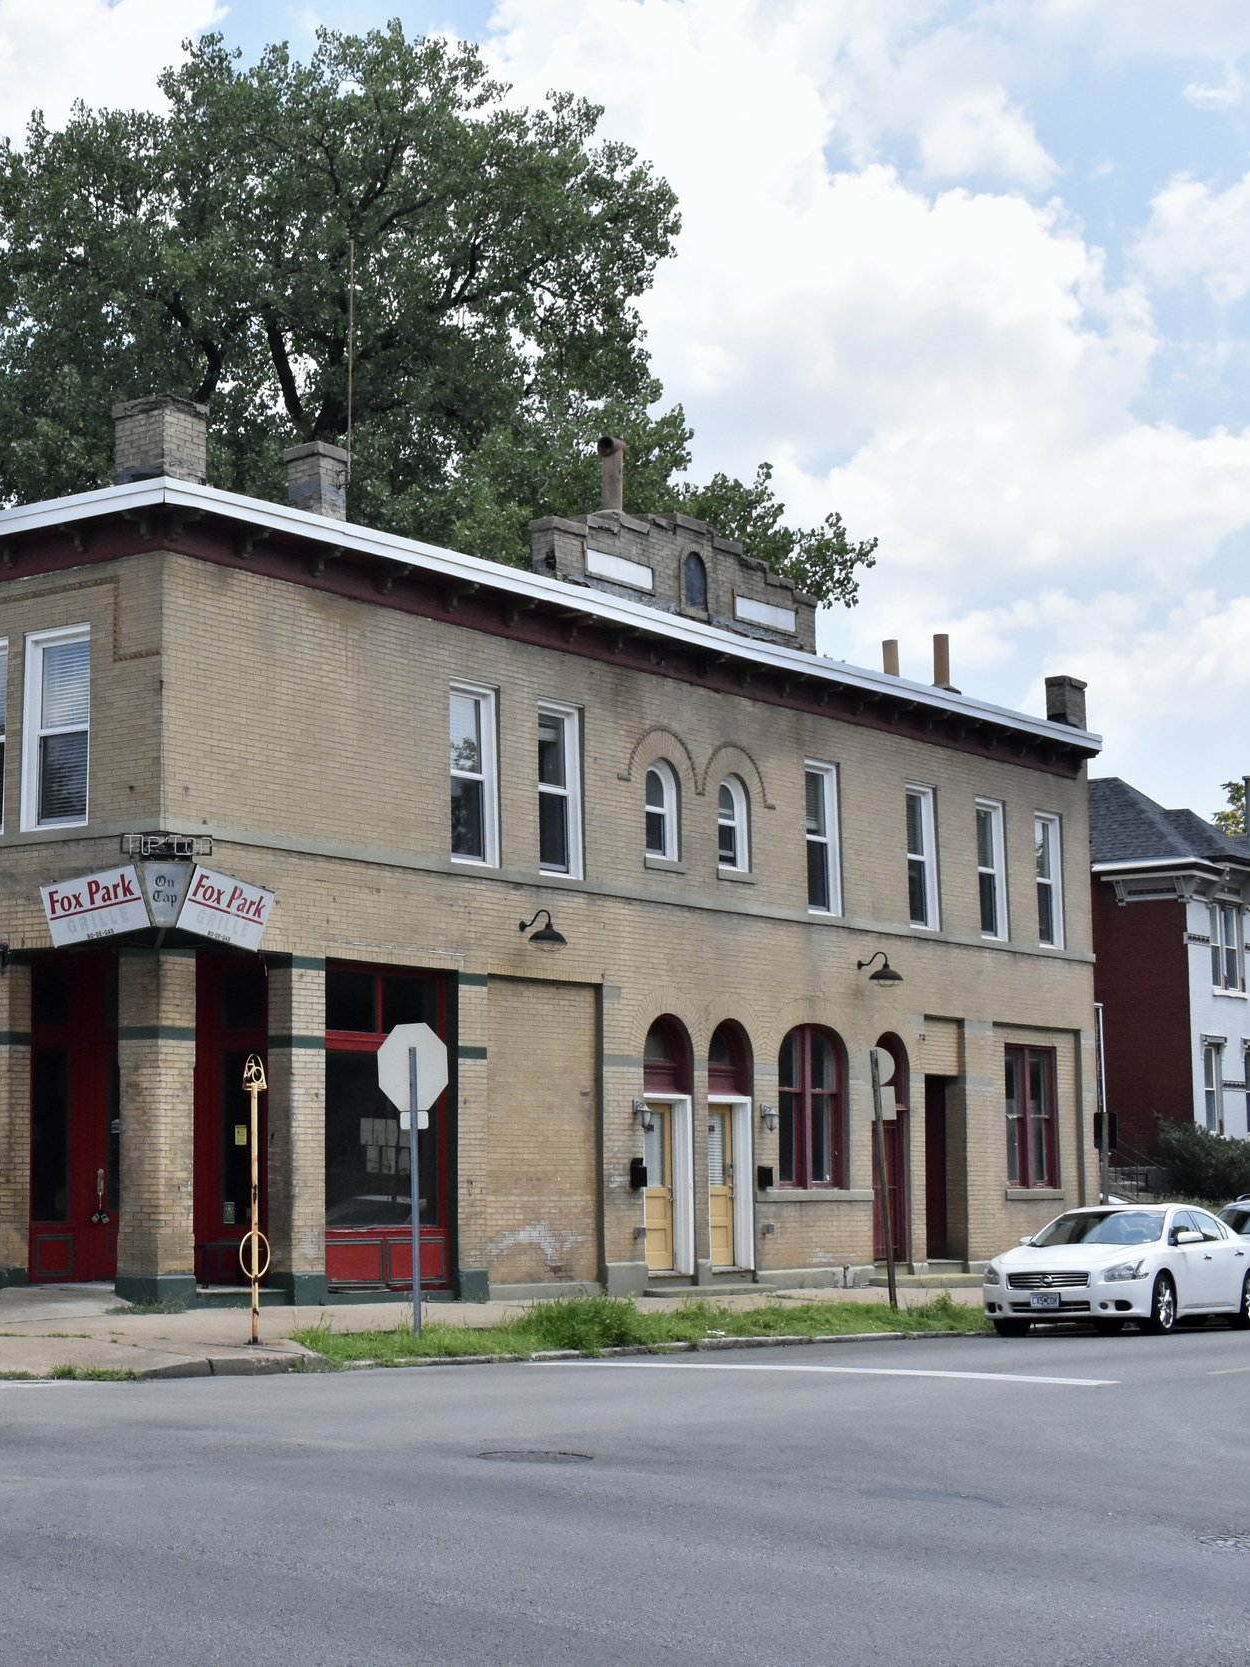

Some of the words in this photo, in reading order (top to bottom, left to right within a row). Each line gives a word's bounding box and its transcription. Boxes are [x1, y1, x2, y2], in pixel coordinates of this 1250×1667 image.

[48, 890, 84, 915] Fox
[87, 874, 135, 906] Park
[155, 875, 175, 888] On
[192, 873, 226, 905] Fox
[226, 885, 266, 919] Park
[153, 889, 178, 907] Tap
[67, 904, 129, 935] GRILLE
[196, 908, 250, 938] GRILLE
